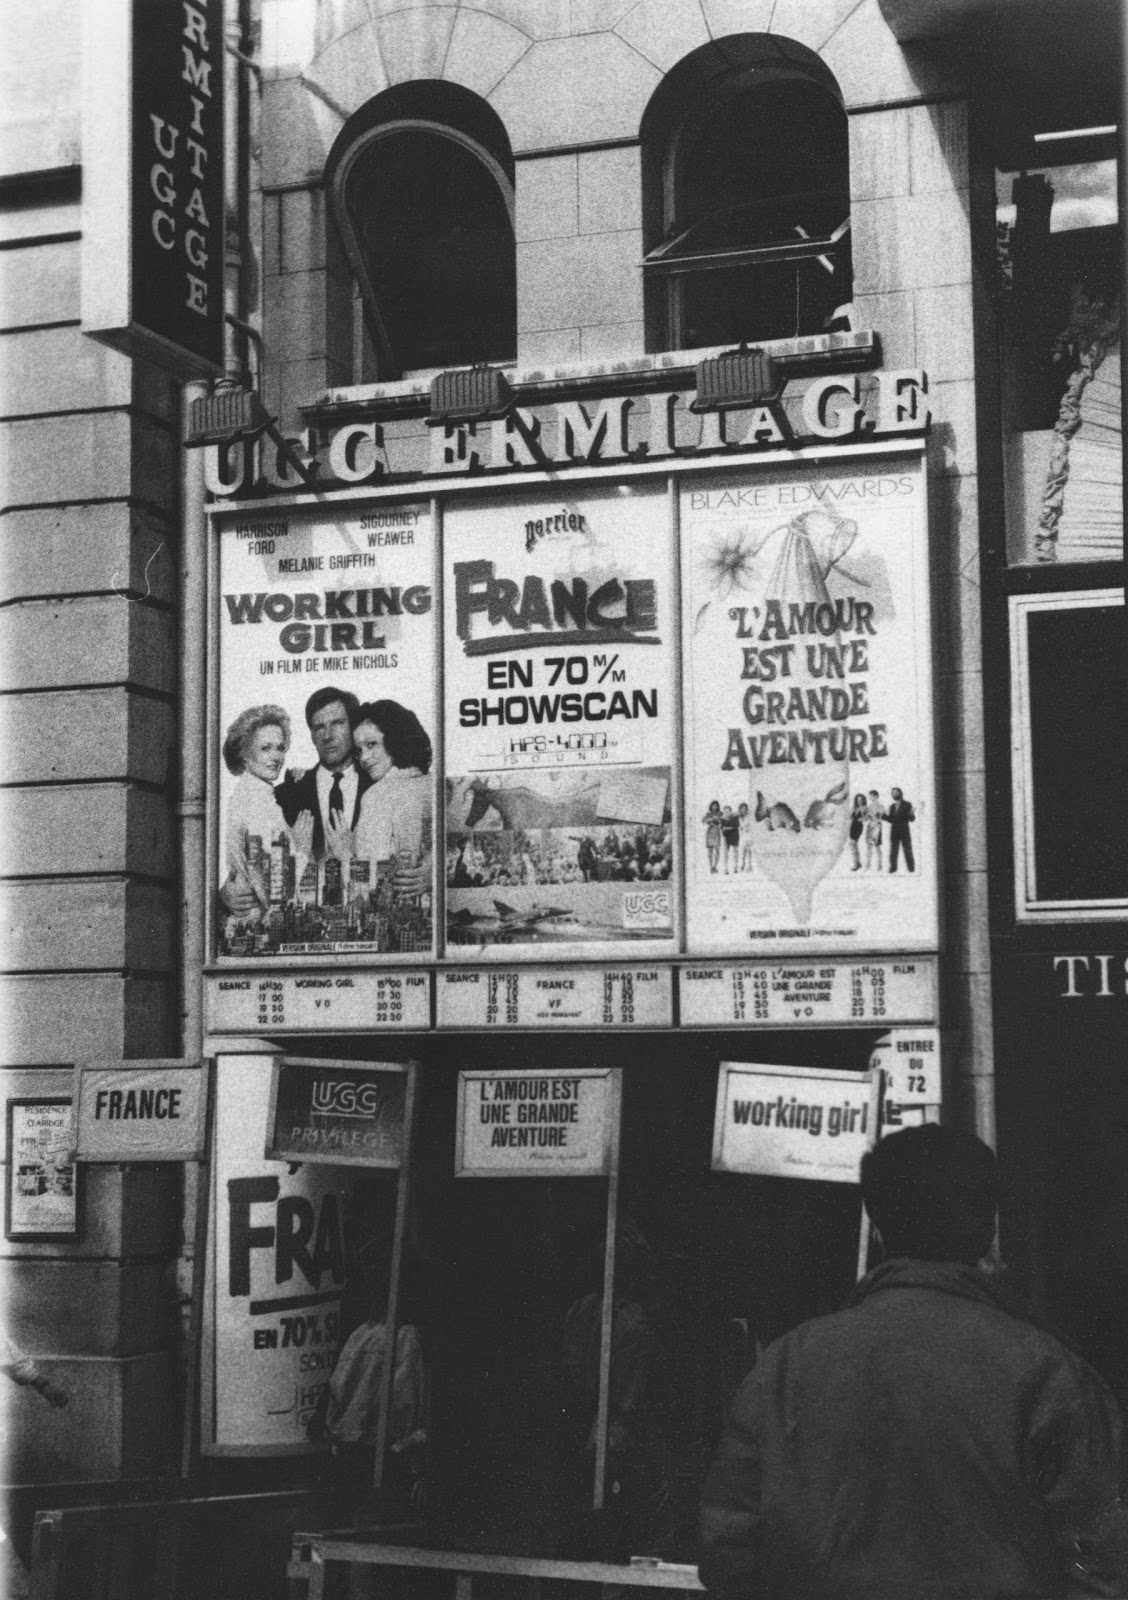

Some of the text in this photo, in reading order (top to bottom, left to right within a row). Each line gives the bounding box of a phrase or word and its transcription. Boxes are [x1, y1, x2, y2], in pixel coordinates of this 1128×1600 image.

[182, 0, 213, 317] RMITAGE
[150, 113, 180, 250] UGC
[422, 369, 932, 474] ERMITAGE
[691, 477, 914, 510] BLAKE EDWARDS
[236, 521, 289, 540] HARRISON
[360, 511, 421, 530] SIGOURNEY
[248, 540, 276, 555] FORD
[278, 553, 376, 573] MELANIE GRIFFITH
[223, 585, 432, 625] WORKING
[453, 559, 658, 641] FRANCE
[728, 597, 877, 641] L'AMOUR
[279, 621, 386, 654] GIRL
[260, 654, 398, 675] UN FILM DE MIKE NICHOLS
[741, 639, 869, 682] EST UNE
[487, 660, 533, 690] EN
[544, 656, 589, 686] 70
[459, 688, 658, 728] SHOWSCAN
[743, 682, 870, 725] GRANDE
[721, 724, 889, 771] AVENTURE
[626, 894, 668, 914] UGC
[446, 973, 480, 983] SEANCE
[636, 972, 658, 981] FILM
[686, 970, 723, 980] SEANCE
[772, 968, 836, 980] L'AMOUR EST
[893, 965, 915, 974] FILM
[1053, 955, 1128, 997] TI
[219, 981, 251, 990] SEANCE
[295, 979, 354, 988] WORKING GIRL
[406, 977, 425, 986] FILM
[536, 980, 575, 989] FRANCE
[772, 981, 832, 991] UNE GRANDE
[549, 999, 562, 1008] VF
[784, 993, 831, 1002] AVENTURE
[794, 1009, 800, 1017] V
[897, 1041, 934, 1052] ENTREE
[480, 1079, 581, 1100] L'AMOUR EST
[908, 1076, 926, 1092] 72
[95, 1089, 181, 1120] FRANCE
[312, 1081, 377, 1114] UGC
[480, 1103, 579, 1124] UNE GRANDE
[733, 1096, 869, 1136] working girl
[291, 1127, 390, 1147] PRIVILEGE
[491, 1127, 567, 1147] AVENTURE
[254, 1329, 278, 1350] EN
[280, 1317, 306, 1348] 70
